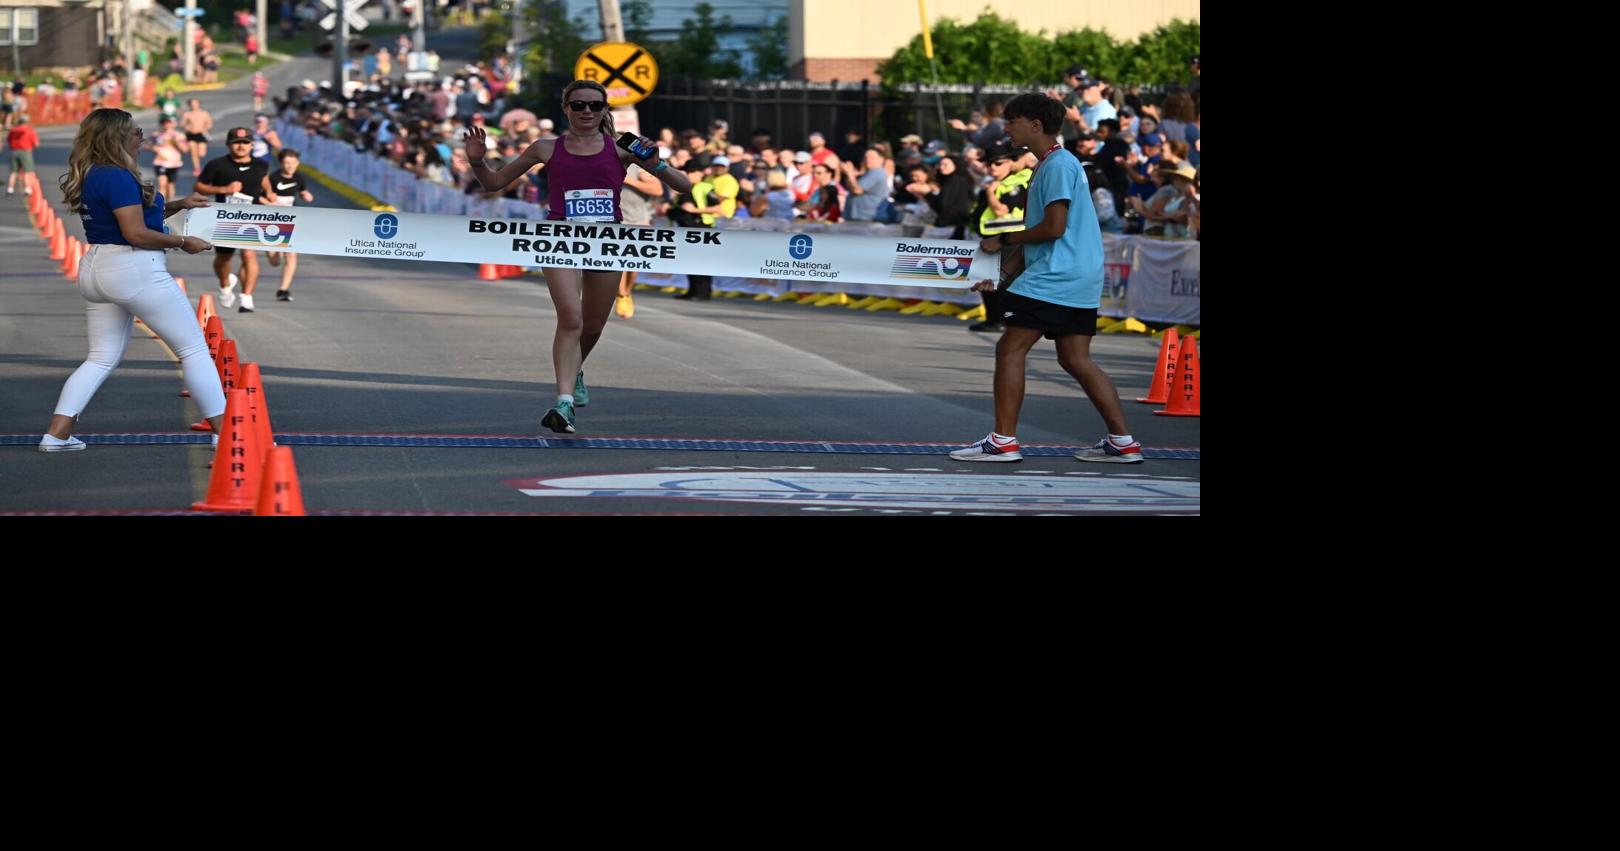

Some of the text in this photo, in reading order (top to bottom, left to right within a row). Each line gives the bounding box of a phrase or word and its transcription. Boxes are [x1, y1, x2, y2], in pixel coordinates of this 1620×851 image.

[635, 65, 650, 79] R
[567, 200, 613, 215] 16653
[216, 209, 296, 222] Boilermaker
[469, 220, 722, 245] BOILERMAKER 5K
[345, 246, 392, 256] Insurance
[350, 239, 417, 250] Utica National
[512, 238, 676, 259] ROAD RACE
[896, 243, 975, 256] Boilermaker
[535, 254, 652, 269] Utica, New York
[765, 259, 832, 270] Utica National
[760, 267, 807, 277] Insurance
[1183, 353, 1194, 401] FLRRT
[231, 415, 245, 488] FLRRT
